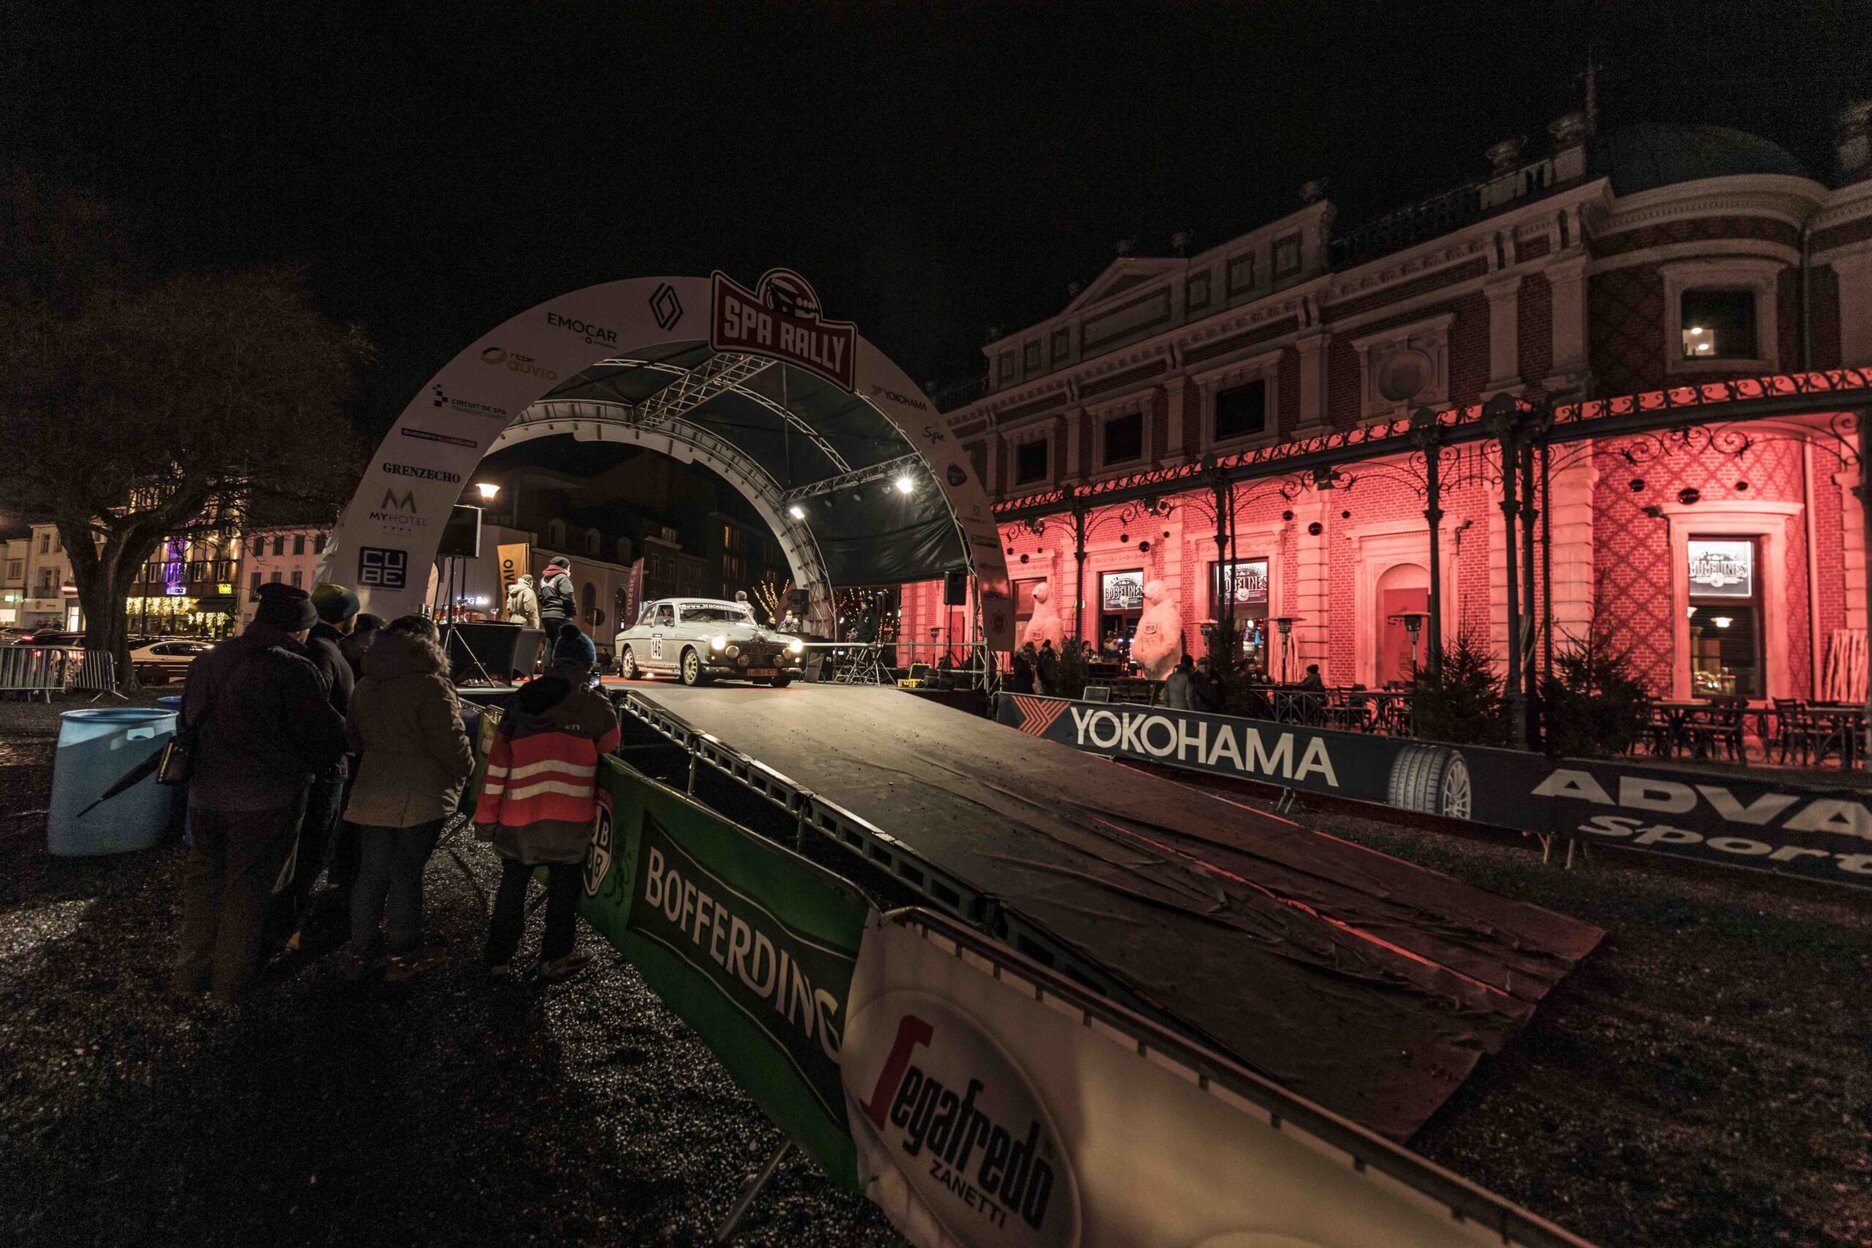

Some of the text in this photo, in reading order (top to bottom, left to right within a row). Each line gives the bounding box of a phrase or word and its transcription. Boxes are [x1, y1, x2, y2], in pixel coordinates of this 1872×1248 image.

[547, 312, 617, 343] EMOCAR
[724, 295, 845, 374] SPA RALLY
[507, 360, 557, 380] auvio
[451, 398, 480, 409] CIRCUIT
[492, 407, 506, 415] SPA
[885, 390, 927, 411] YOKOHAMA
[383, 462, 460, 484] GRENZECHO
[369, 511, 426, 527] MYHOTEL
[1070, 706, 1339, 788] YOKOHAMA
[1530, 768, 1872, 840] ADVA
[1577, 815, 1872, 875] Sport
[646, 846, 840, 1066] BOFFERDING
[859, 1014, 1055, 1231] Segafredo
[929, 1161, 1006, 1229] ZANETTI
